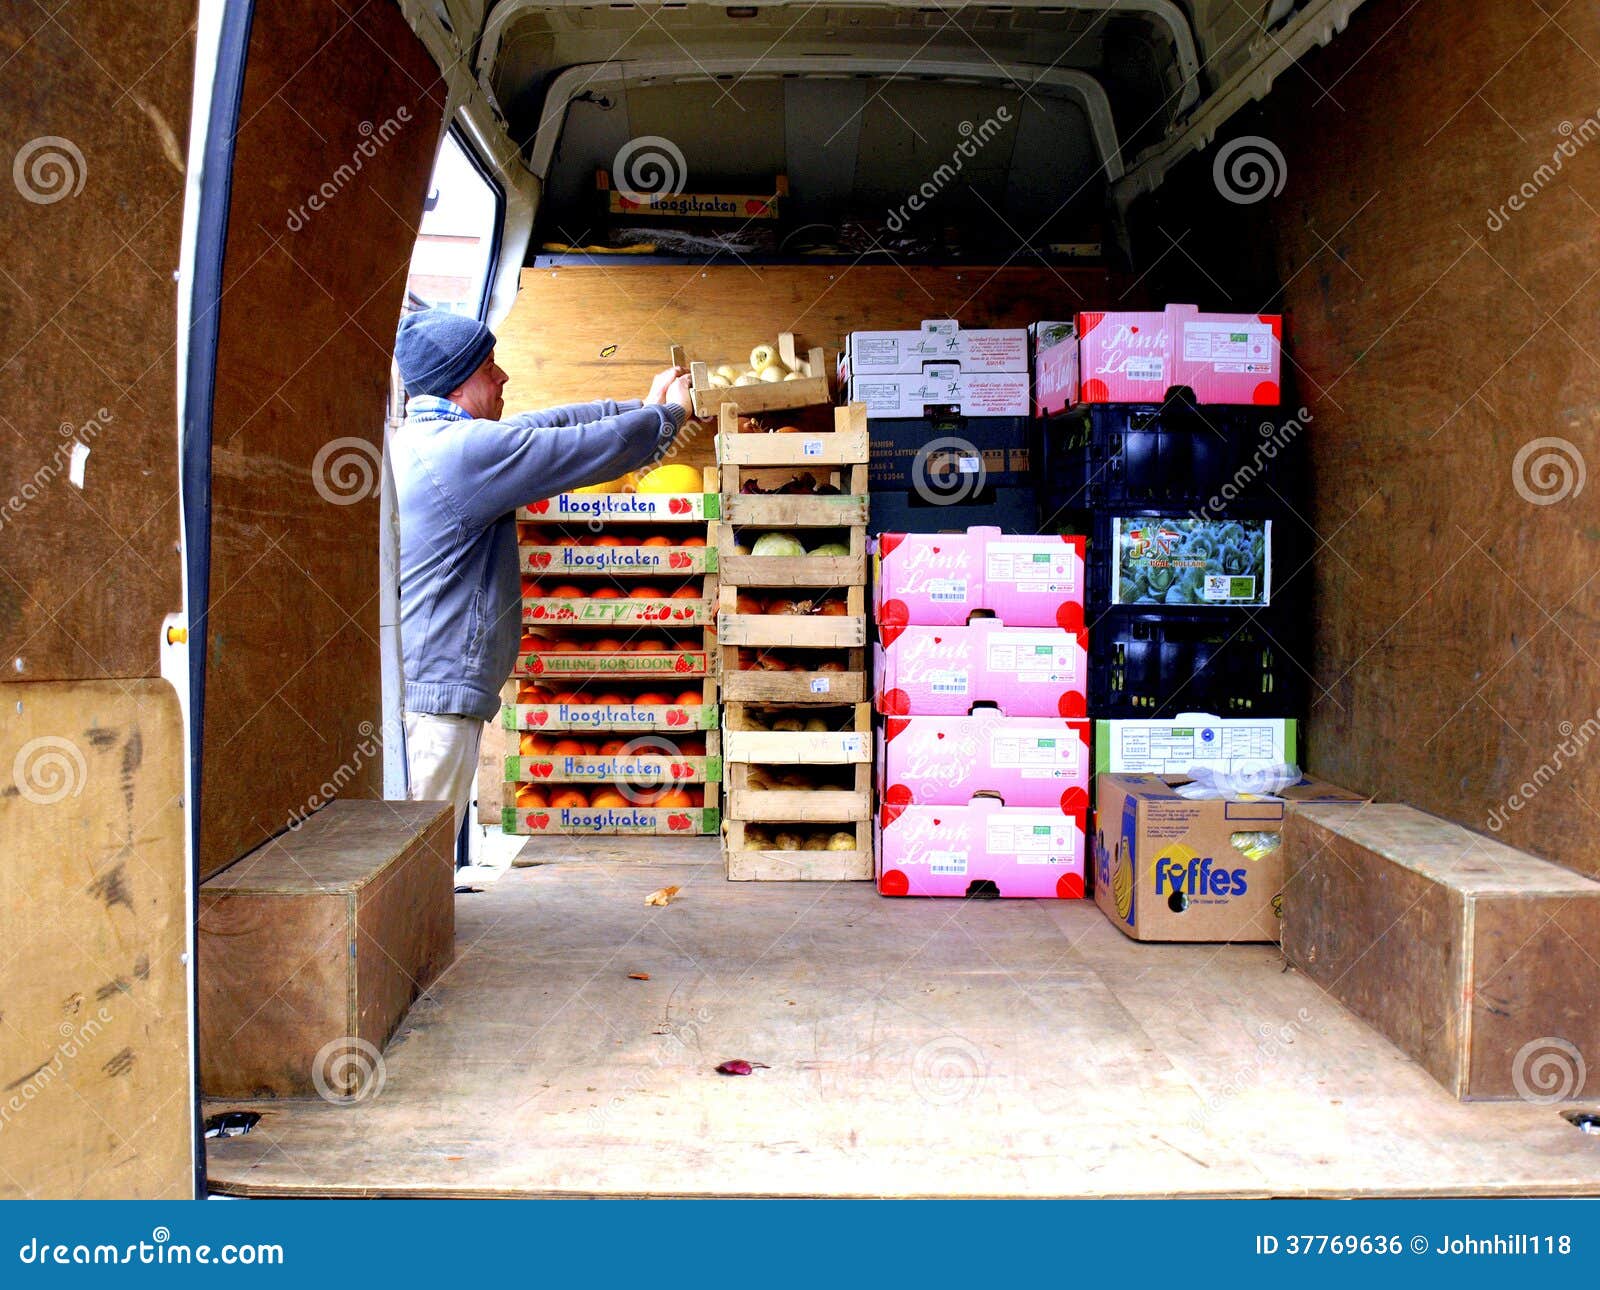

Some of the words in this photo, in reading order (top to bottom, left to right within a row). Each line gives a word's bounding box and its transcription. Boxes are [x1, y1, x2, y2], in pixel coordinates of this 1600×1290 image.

[903, 544, 971, 569] Pink
[547, 658, 595, 670] VEILING
[600, 658, 672, 670] BORGLOON
